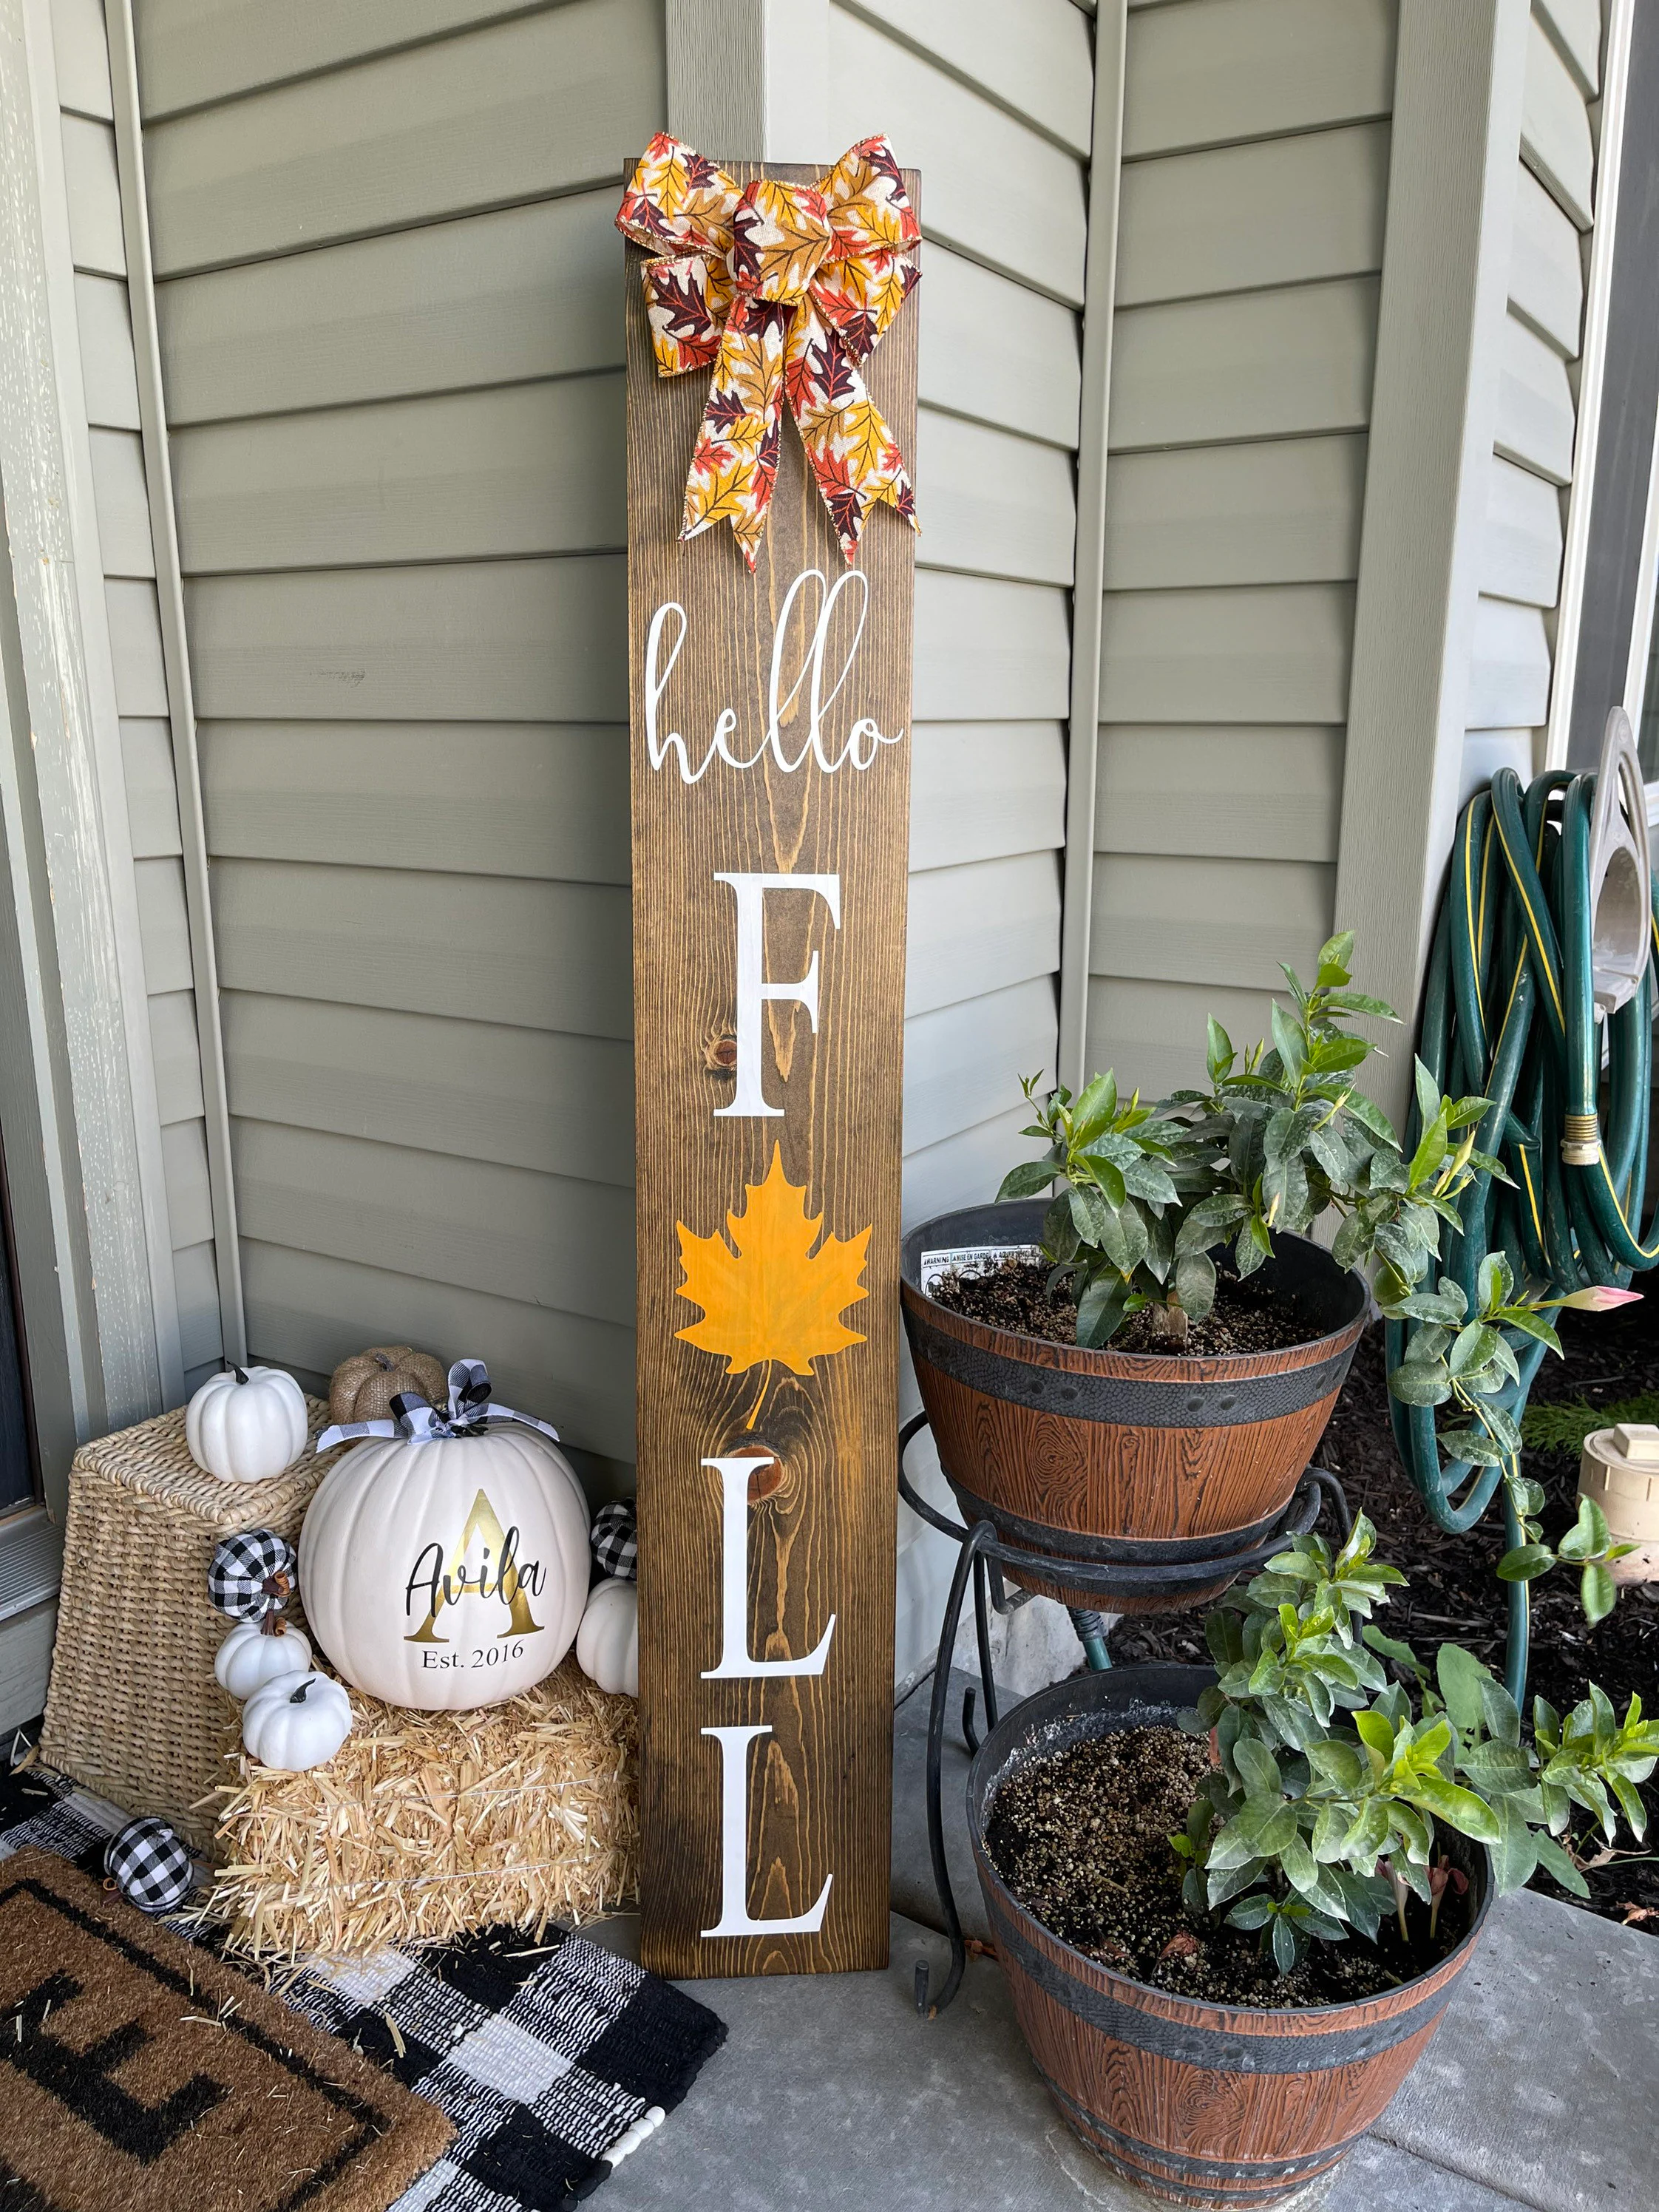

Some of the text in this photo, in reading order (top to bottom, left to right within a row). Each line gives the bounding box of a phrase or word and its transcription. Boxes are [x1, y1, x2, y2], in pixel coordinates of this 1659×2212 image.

[645, 569, 904, 784] hello
[927, 1256, 949, 1265] WARNING
[405, 1526, 547, 1618] Avila
[421, 1638, 524, 1669] Est. 2016
